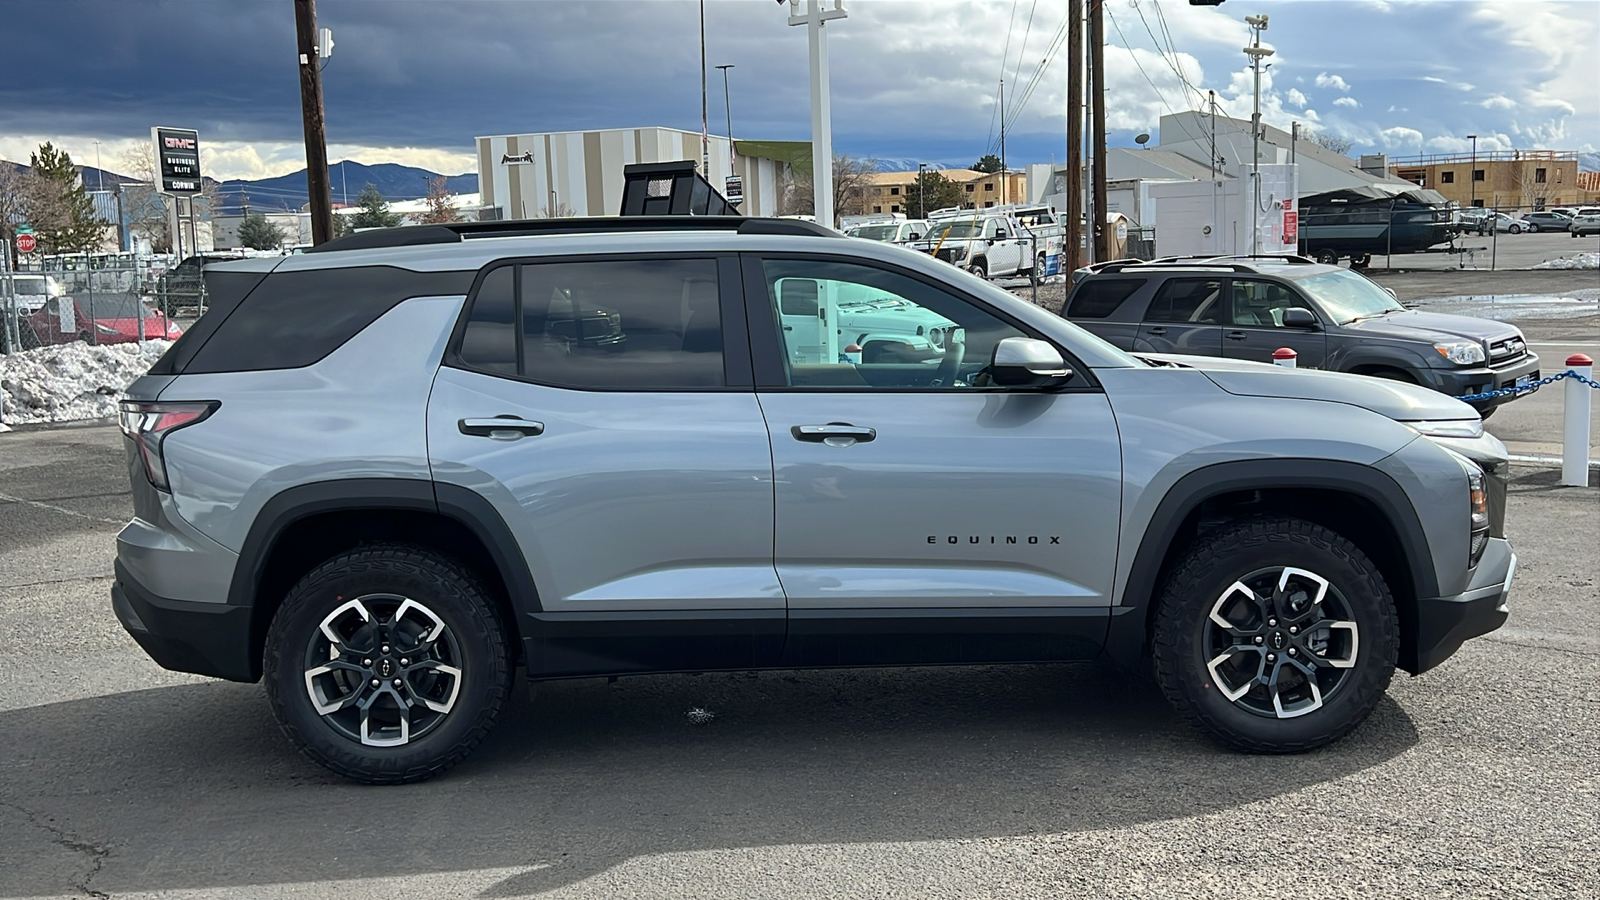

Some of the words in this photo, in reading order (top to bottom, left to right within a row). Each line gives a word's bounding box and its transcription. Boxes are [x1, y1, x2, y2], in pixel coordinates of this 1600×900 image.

[164, 137, 195, 149] GMC
[168, 157, 195, 165] BUSINESS
[172, 181, 194, 189] CORWIN
[19, 239, 34, 247] STOP
[927, 536, 1060, 545] EQUINOX
